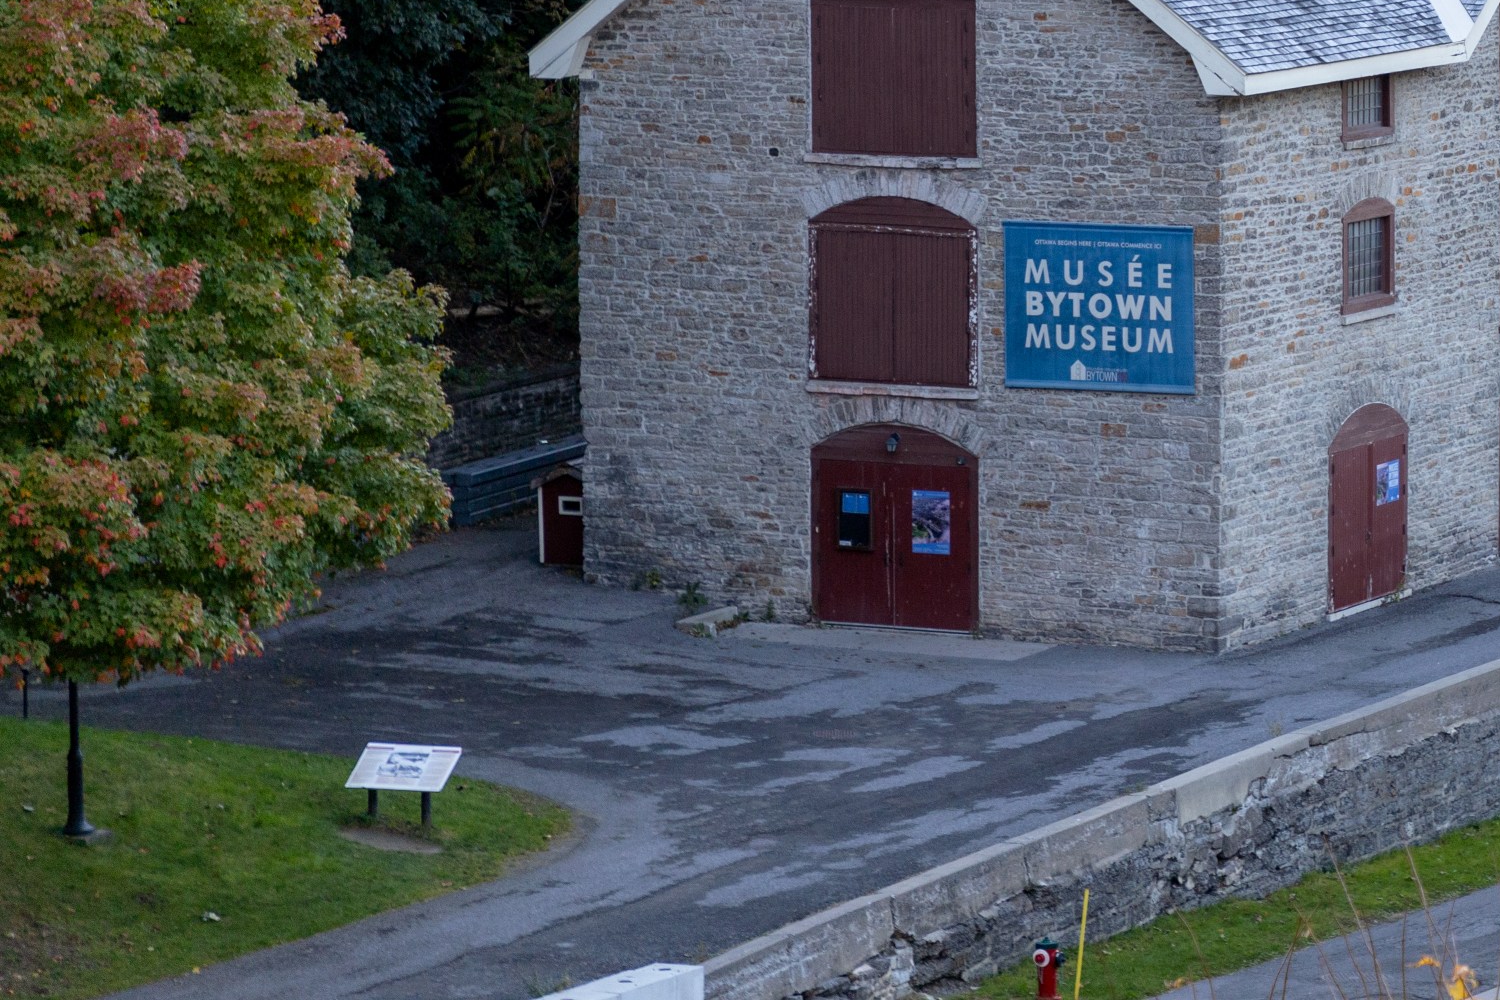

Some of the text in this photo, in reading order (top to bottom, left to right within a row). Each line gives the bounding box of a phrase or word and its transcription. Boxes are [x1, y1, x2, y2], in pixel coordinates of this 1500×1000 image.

[1057, 239, 1078, 247] BEGINS
[1024, 254, 1172, 289] MUSÉE
[1025, 291, 1173, 321] BYTOWN
[1024, 323, 1174, 354] MUSEUM
[1086, 370, 1118, 382] BYTOWN
